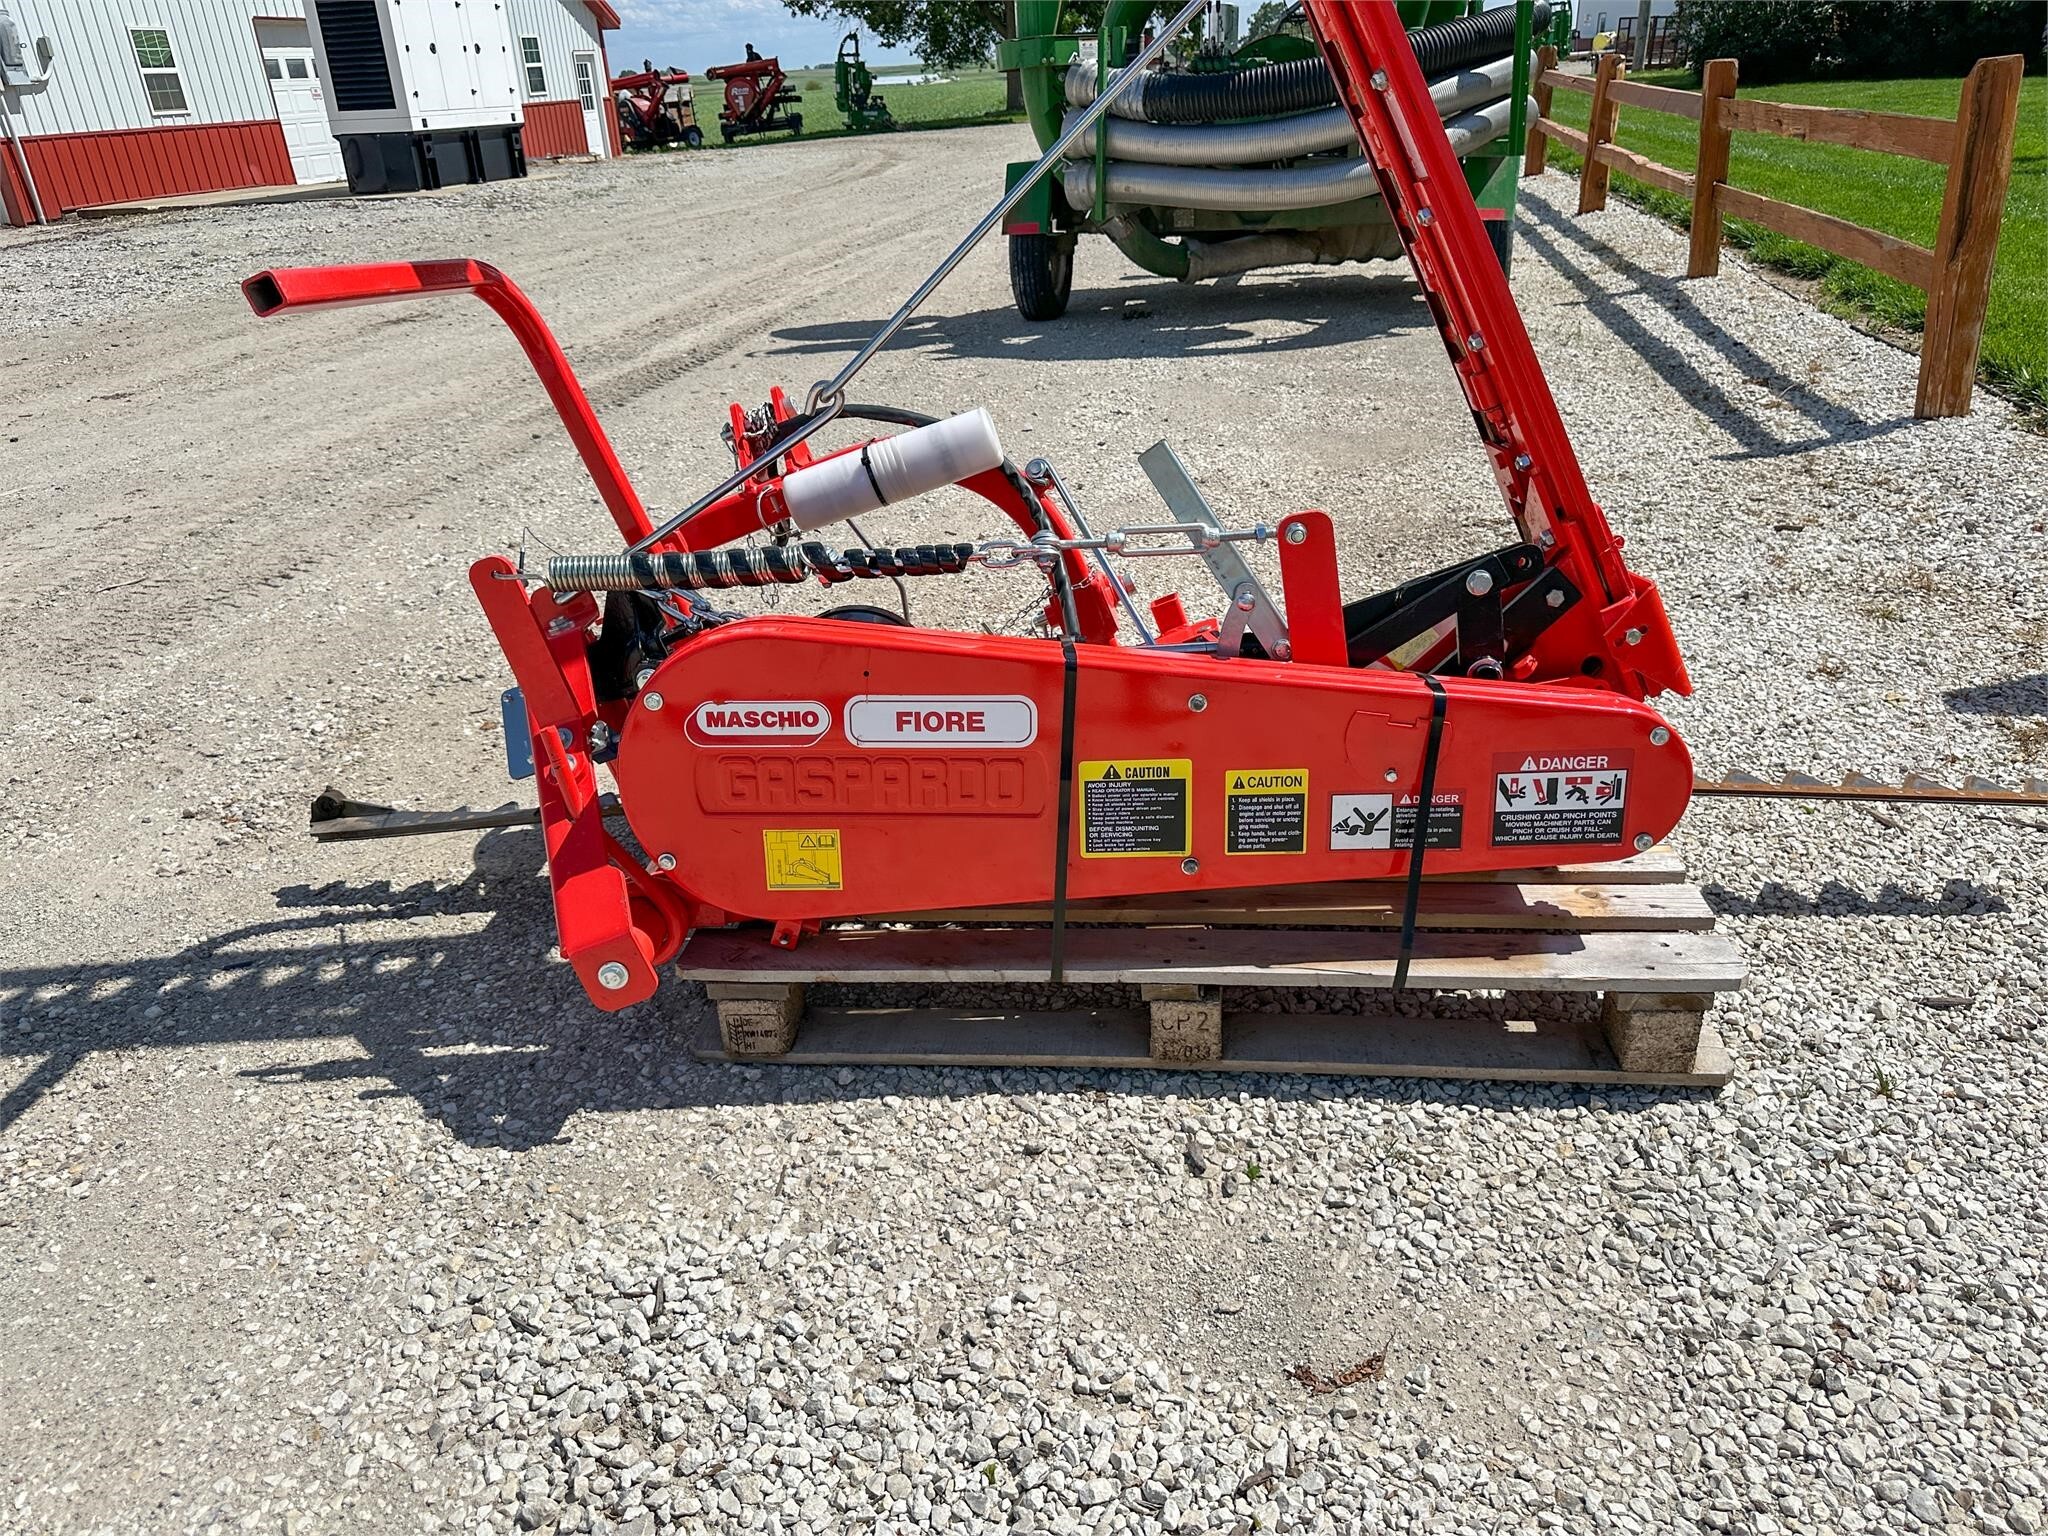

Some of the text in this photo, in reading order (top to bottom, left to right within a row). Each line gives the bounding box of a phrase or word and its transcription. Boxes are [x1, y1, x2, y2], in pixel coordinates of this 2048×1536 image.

[705, 709, 820, 730] MASCHIO
[895, 711, 987, 733] FIORE
[1539, 755, 1609, 770] DANGER
[1125, 766, 1170, 779] CAUTION
[717, 756, 1027, 809] GASPARDO
[1247, 775, 1303, 788] CAUTION
[1412, 794, 1459, 804] DNGER
